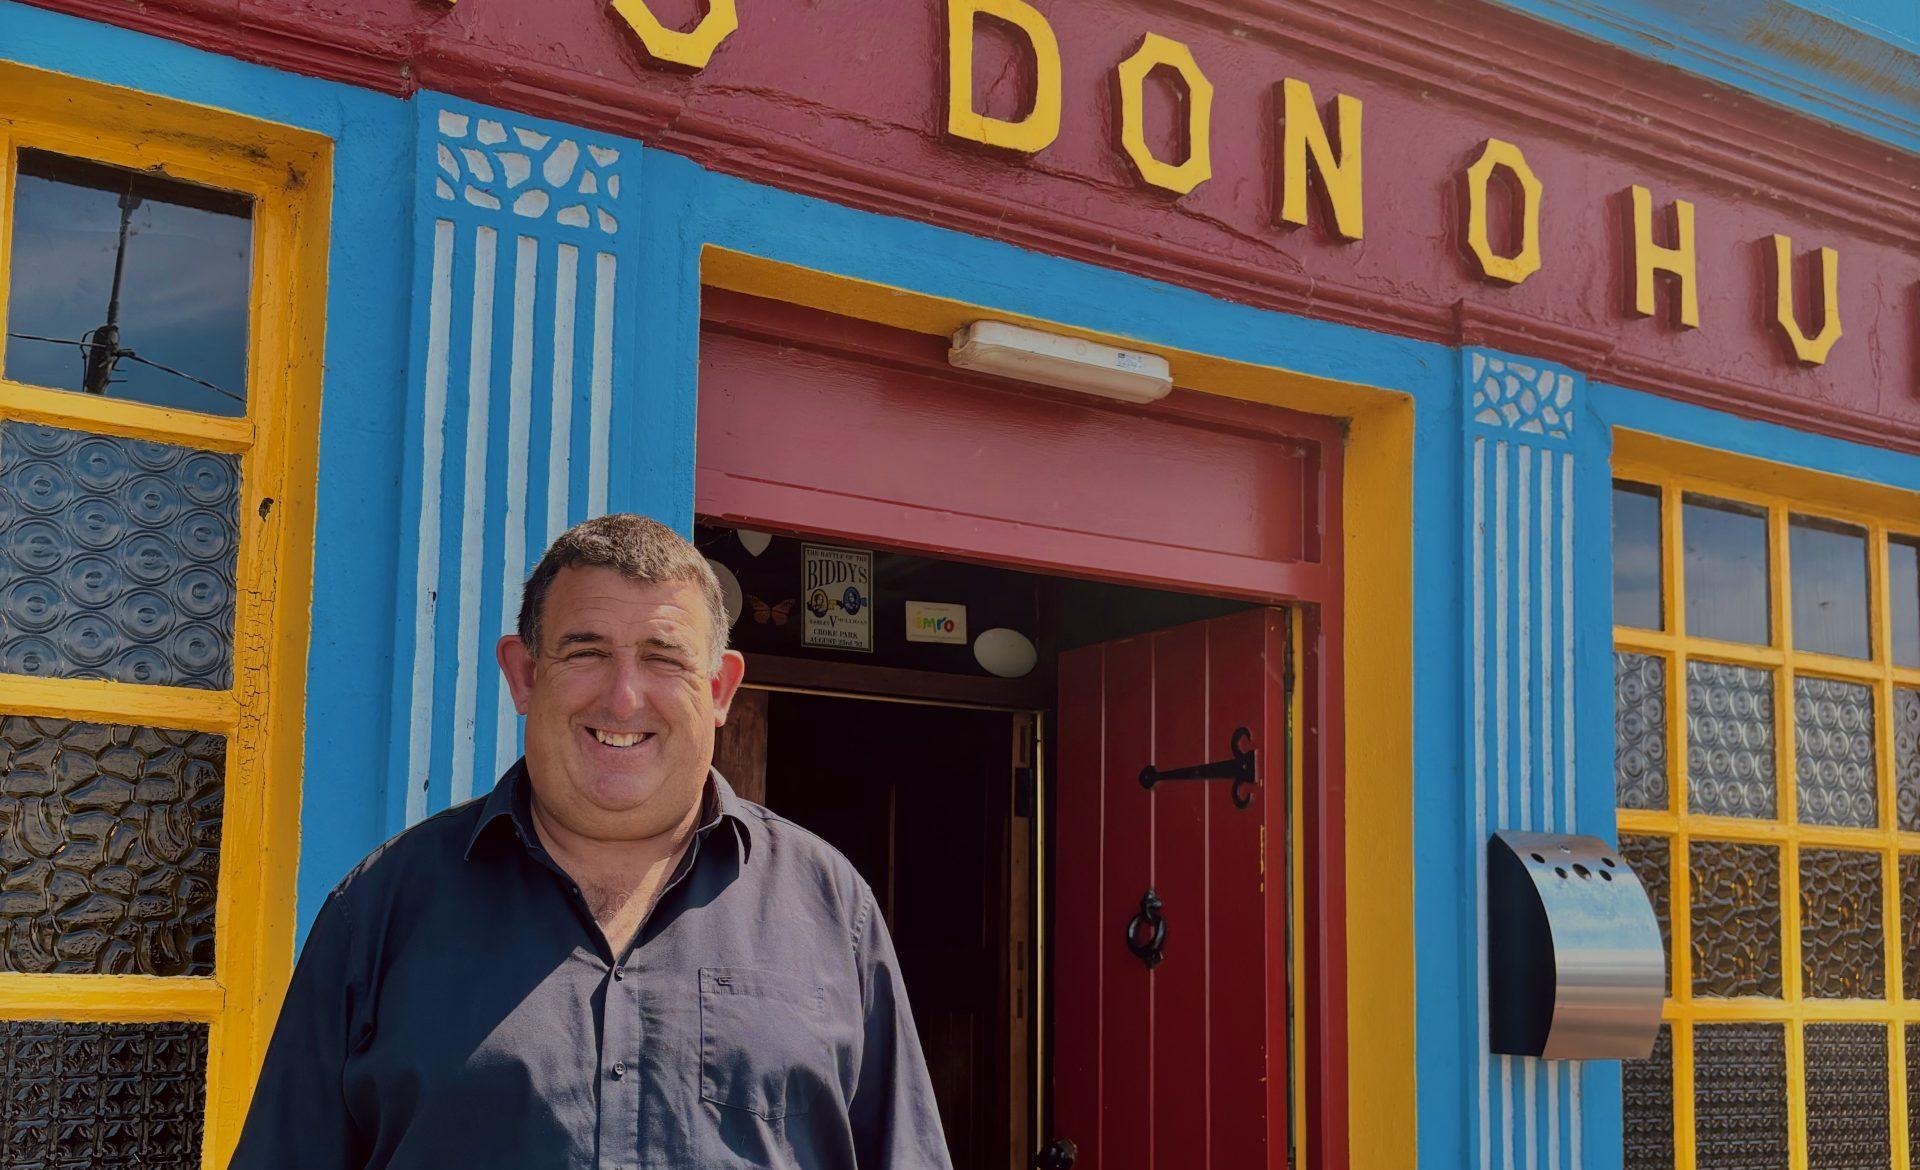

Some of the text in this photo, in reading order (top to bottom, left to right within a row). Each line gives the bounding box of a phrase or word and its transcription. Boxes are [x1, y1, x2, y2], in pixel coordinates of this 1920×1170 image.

[808, 560, 868, 590] BIDDYS
[916, 610, 954, 633] imro
[839, 631, 858, 639] PARK
